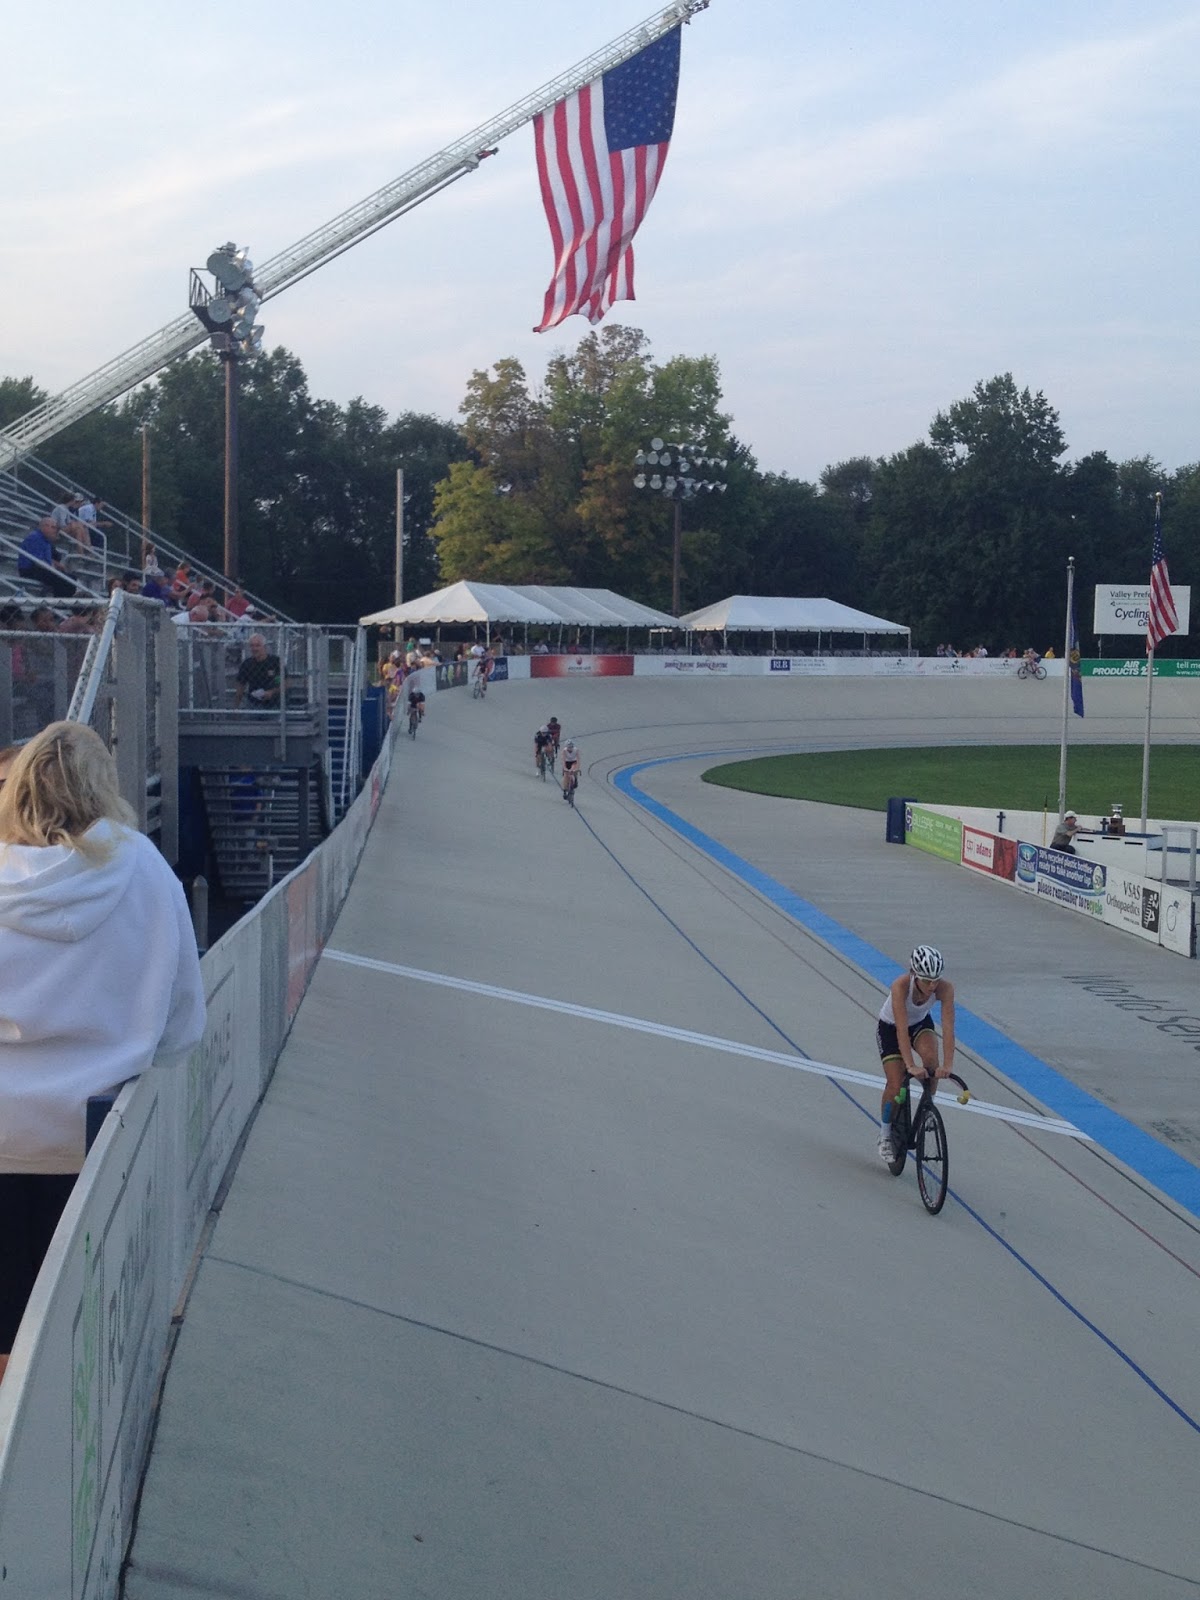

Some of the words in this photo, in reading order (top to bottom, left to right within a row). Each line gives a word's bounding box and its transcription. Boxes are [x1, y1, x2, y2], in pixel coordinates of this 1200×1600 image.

[1110, 591, 1131, 599] Valley
[1115, 608, 1150, 620] Cycling
[1092, 667, 1139, 675] PRODUCTS
[976, 842, 992, 858] adams
[1037, 879, 1052, 896] please
[1052, 886, 1078, 907] remember
[1123, 880, 1141, 901] VSAS
[1106, 893, 1140, 916] Orthopaedics
